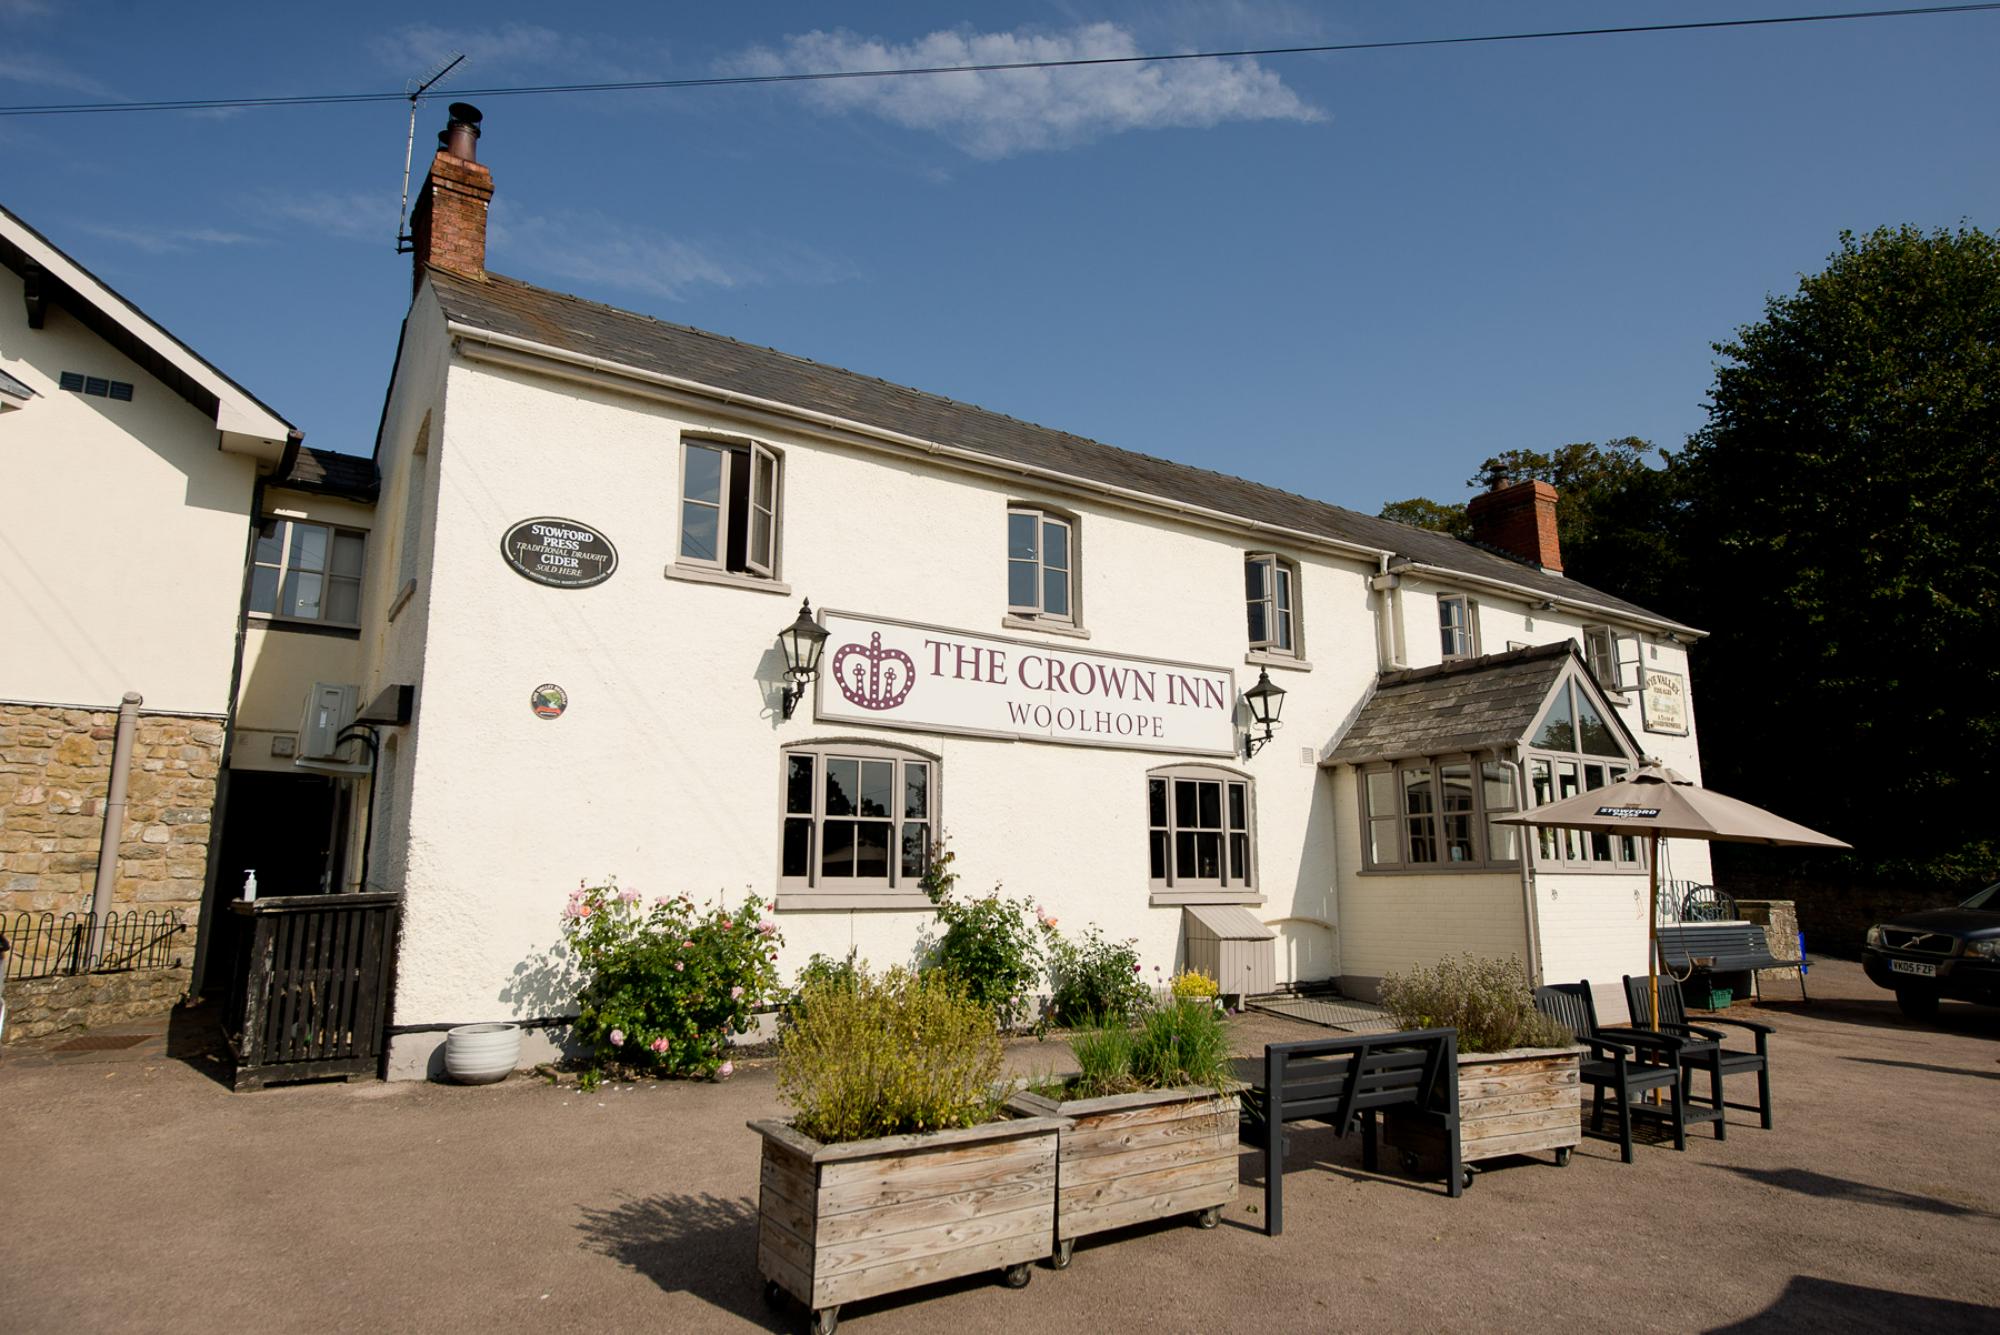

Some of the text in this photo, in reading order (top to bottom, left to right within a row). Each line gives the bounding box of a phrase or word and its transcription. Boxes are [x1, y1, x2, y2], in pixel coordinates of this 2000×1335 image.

[531, 524, 594, 543] STOWFORD
[516, 541, 608, 562] TRADITIONAL DRAUGHT
[543, 536, 580, 551] PRESS
[535, 564, 583, 577] SOLD HERE
[541, 554, 579, 568] CIDER
[924, 638, 1226, 711] THE CROWN INN
[1007, 700, 1166, 739] WOOLHOPE
